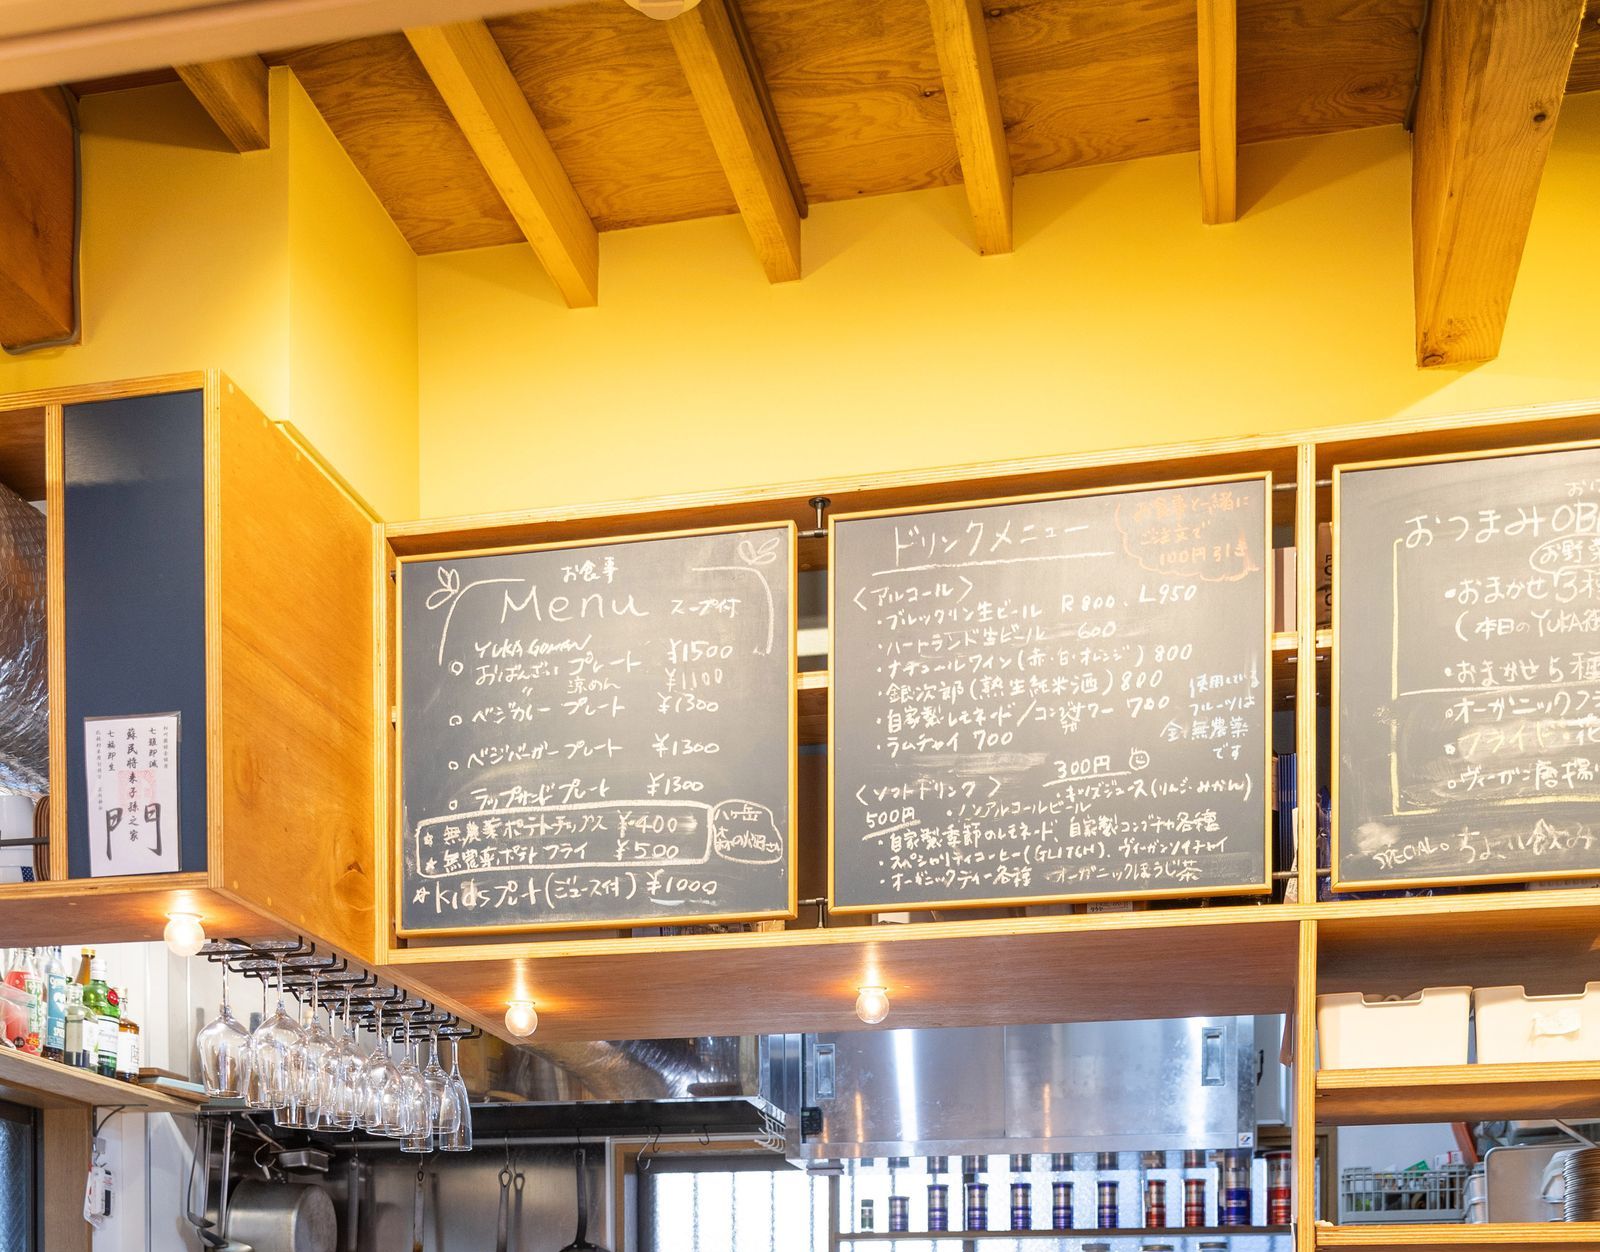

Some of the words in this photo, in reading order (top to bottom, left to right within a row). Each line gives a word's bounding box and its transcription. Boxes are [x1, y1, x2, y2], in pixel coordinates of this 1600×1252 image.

[895, 519, 1089, 567] ドリンクメニュー
[561, 556, 618, 583] お食事
[501, 585, 649, 623] Menu
[671, 598, 741, 618] スープ付
[886, 599, 1043, 630] ブルックリン生ビール
[887, 622, 1048, 656] ハートランド生ビール
[1077, 621, 1117, 640] 600
[568, 652, 642, 676] プレート
[667, 638, 734, 664] ¥1500
[1154, 643, 1194, 663] 800
[567, 677, 622, 697] 涼めん
[665, 667, 723, 693] ¥1100
[1121, 669, 1164, 691] 800
[472, 701, 552, 724] ベジカレー
[561, 696, 625, 718] プレート
[657, 692, 719, 715] ¥1300
[1127, 696, 1170, 718] 700
[1188, 696, 1256, 717] フルーツは
[1454, 691, 1600, 724] オーガニックフ
[467, 738, 560, 769] ベジバーガー
[564, 737, 624, 760] プレート
[652, 733, 720, 758] ¥1300
[887, 731, 959, 758] ラムチャイ
[972, 729, 1013, 751] 700
[1213, 742, 1242, 761] です
[1053, 755, 1111, 779] 300円
[558, 777, 611, 804] プレート
[646, 772, 705, 797] ¥1300
[865, 806, 916, 829] 500円
[613, 840, 680, 862] ¥500
[646, 868, 718, 896] ¥1000
